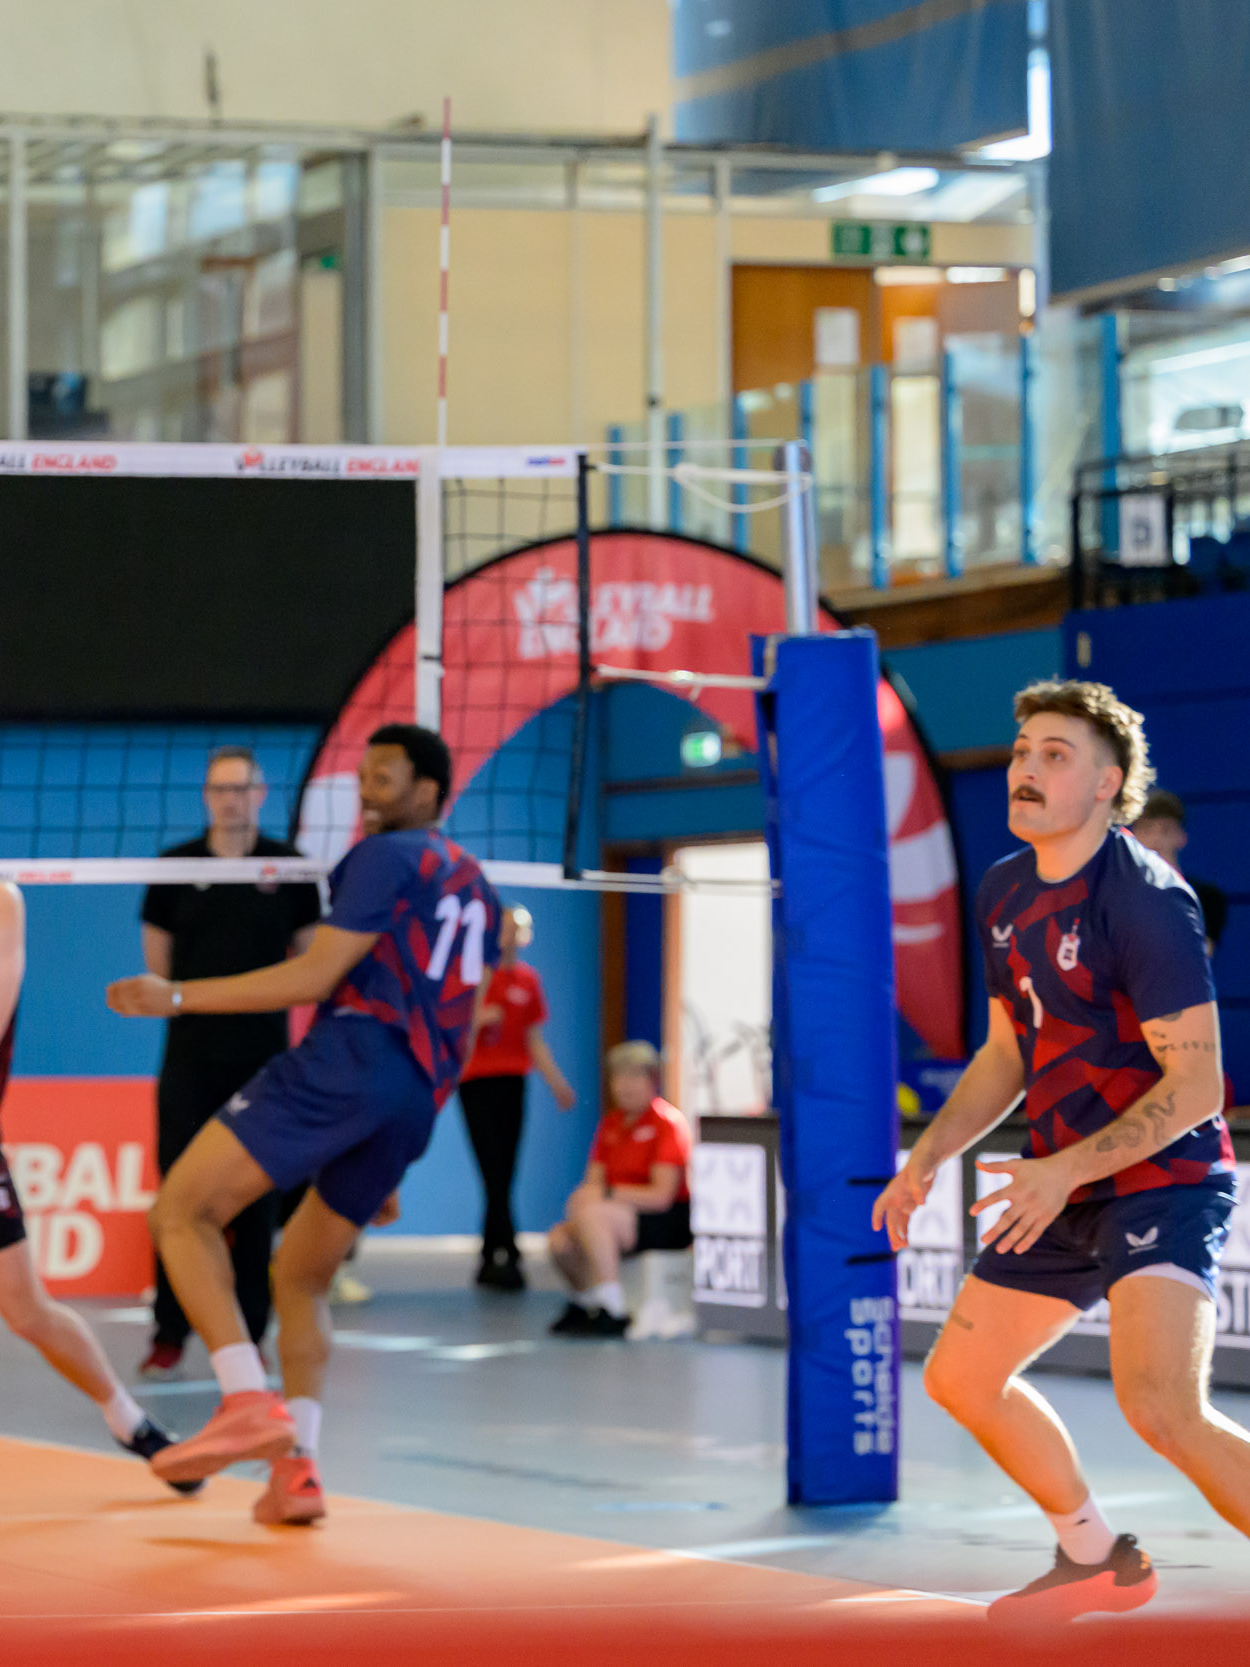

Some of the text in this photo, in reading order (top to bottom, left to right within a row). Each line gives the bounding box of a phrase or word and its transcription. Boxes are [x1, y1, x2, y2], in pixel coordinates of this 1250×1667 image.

[347, 455, 420, 476] ENGLAN
[425, 893, 487, 986] 11
[844, 1298, 874, 1456] Sports
